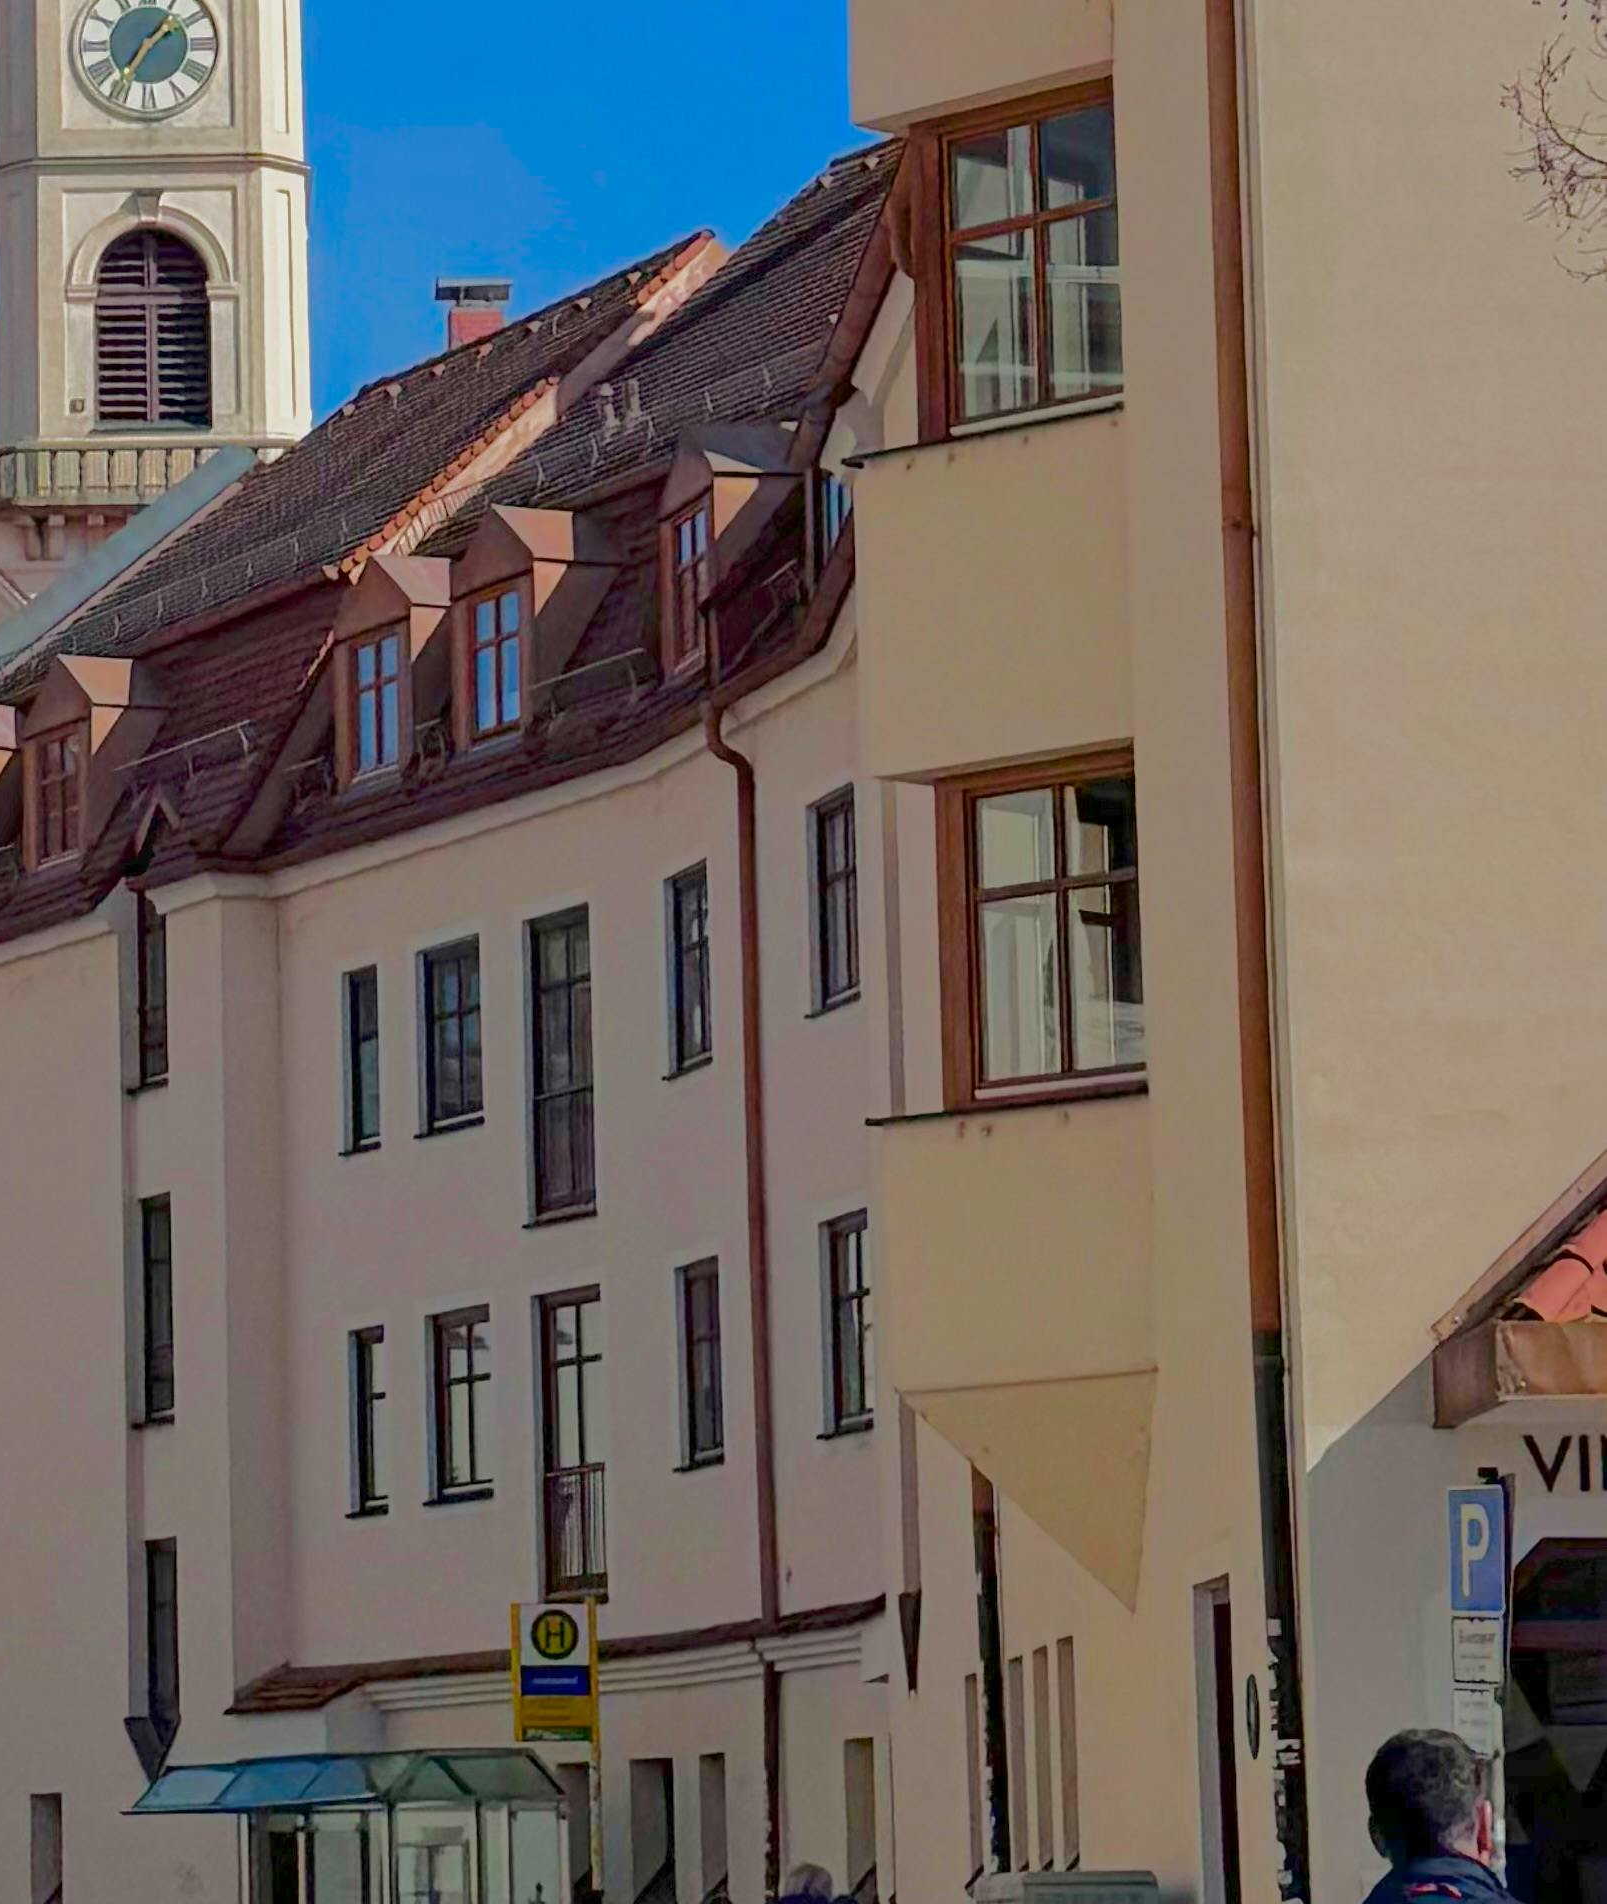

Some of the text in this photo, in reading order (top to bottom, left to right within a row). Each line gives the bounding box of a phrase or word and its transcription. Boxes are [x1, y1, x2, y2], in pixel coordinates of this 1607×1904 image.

[1523, 1434, 1607, 1493] VI
[1460, 1503, 1490, 1597] P
[546, 1620, 564, 1648] H
